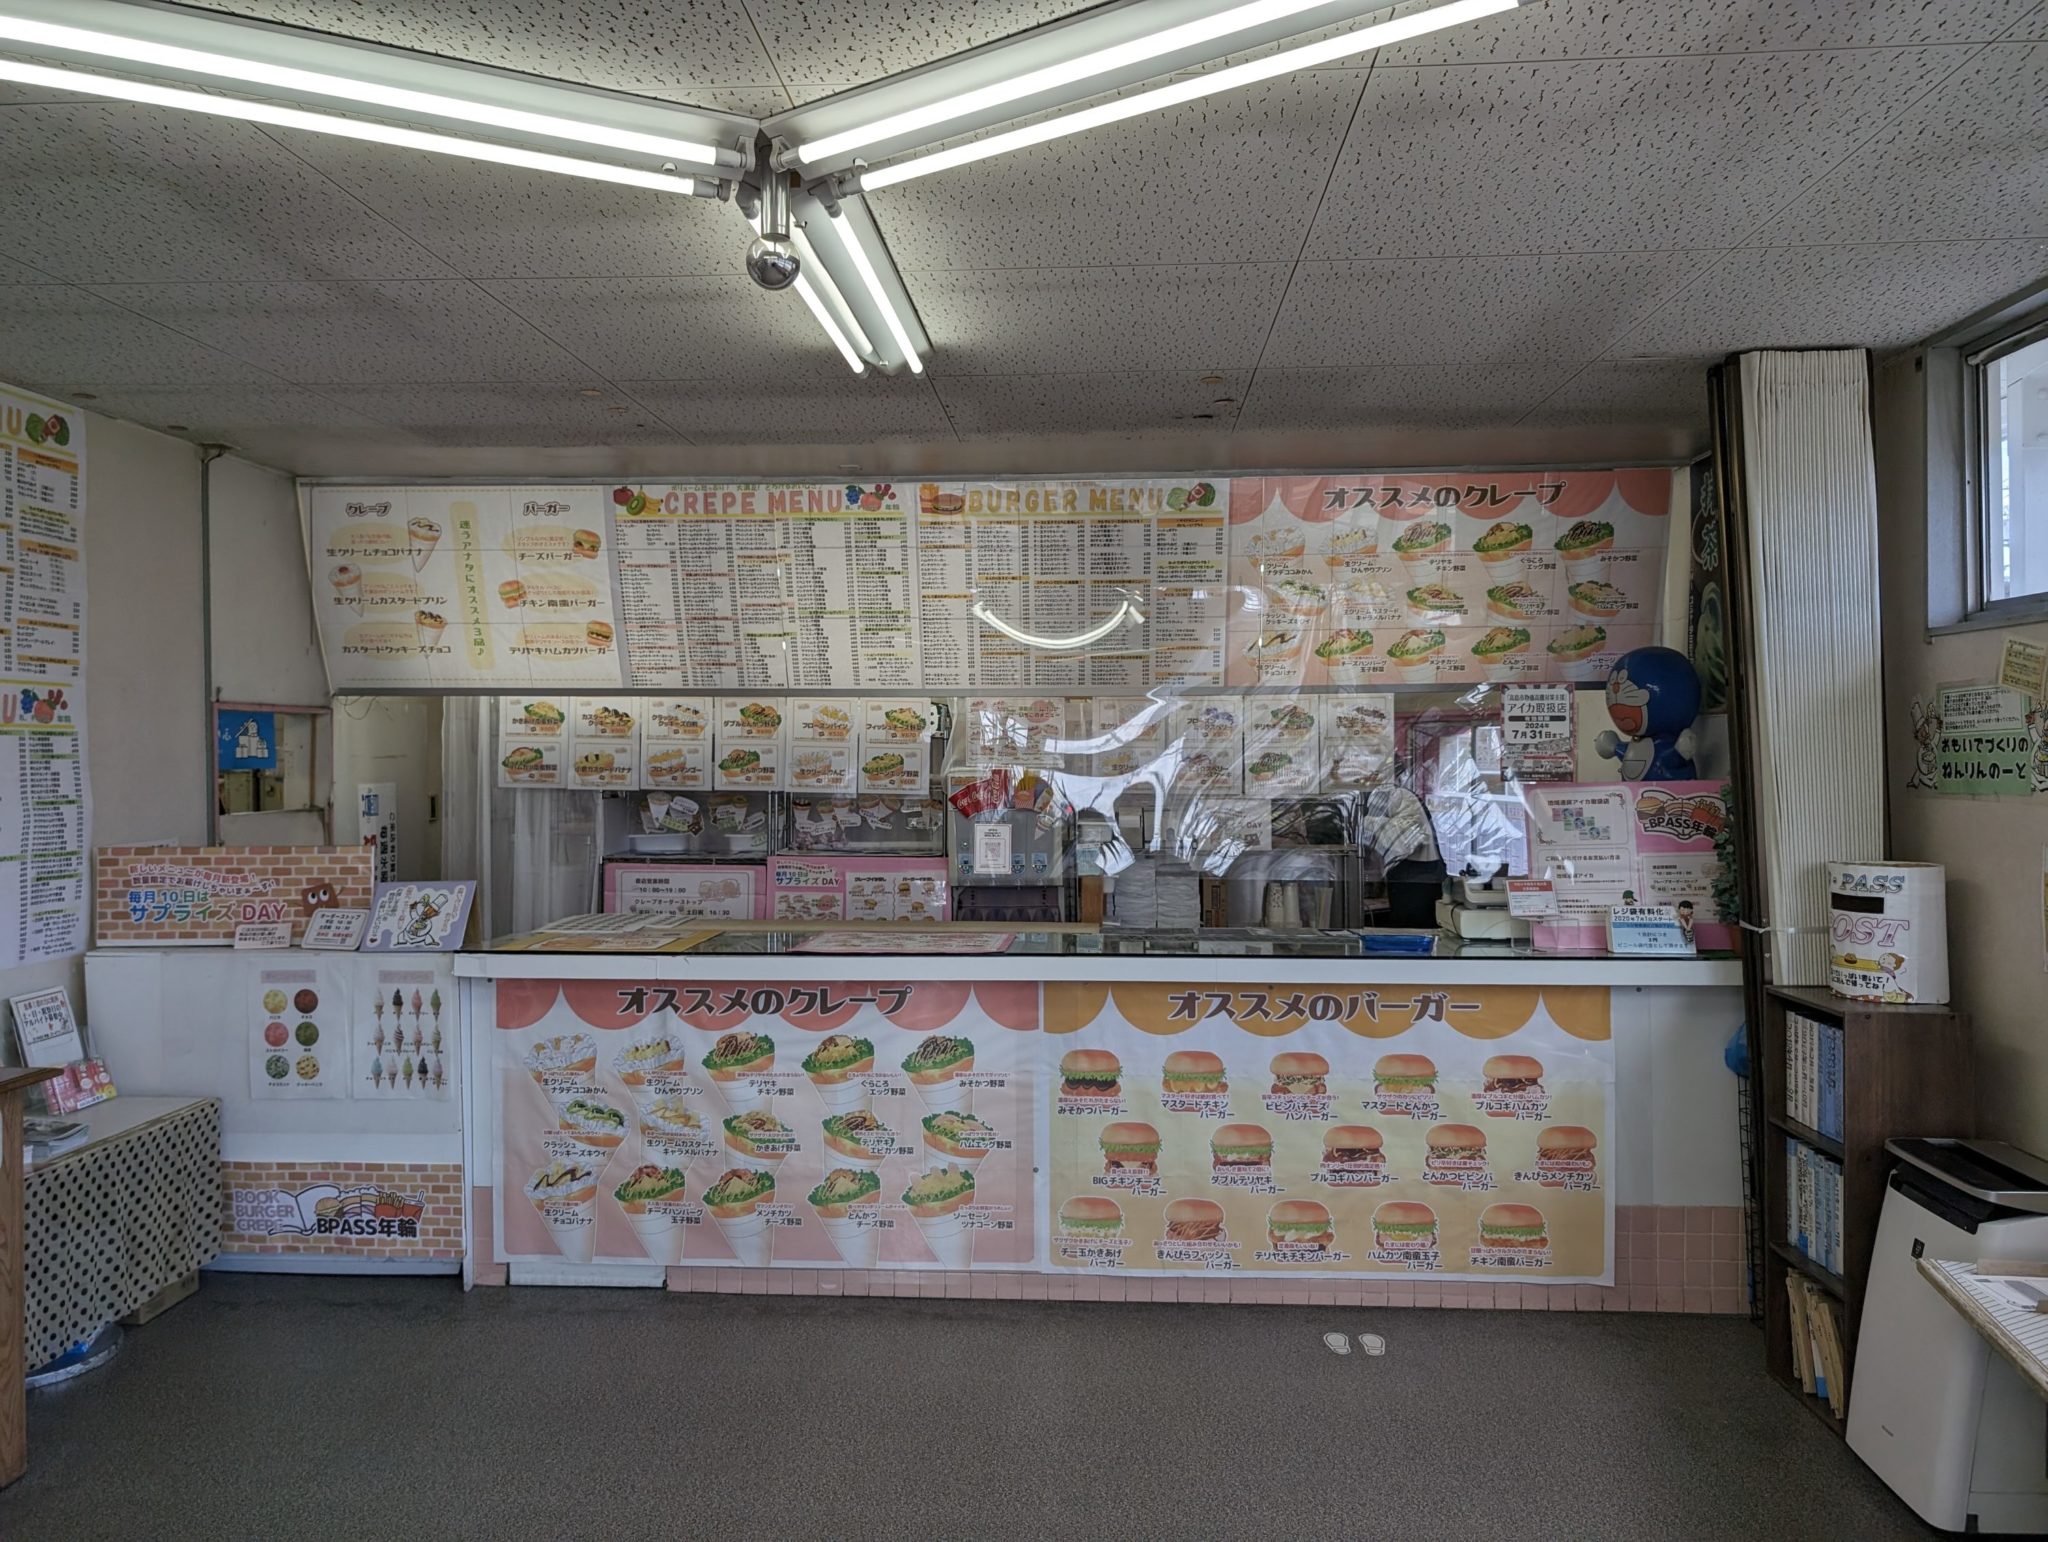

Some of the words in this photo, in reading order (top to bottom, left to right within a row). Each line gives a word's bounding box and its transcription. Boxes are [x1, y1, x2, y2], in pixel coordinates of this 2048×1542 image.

[968, 489, 1078, 513] BURGER
[1089, 487, 1163, 512] MENU
[1323, 481, 1568, 509] オススメのクレープ
[664, 491, 756, 514] CREPE
[768, 489, 842, 514] MENU
[346, 502, 392, 517] クレープ
[523, 502, 570, 516] バーガー
[518, 552, 582, 561] チーズバーガー
[1507, 703, 1567, 713] アイカ取扱店
[1512, 730, 1564, 740] 7月31日まで
[1941, 737, 2029, 753] おもいでづくりの
[1941, 761, 2026, 779] ねんりんのーと
[776, 877, 820, 886] サプライズ
[822, 878, 840, 886] DAY
[634, 898, 703, 906] クレープオーダーストップ
[129, 902, 237, 923] サプライズ
[242, 903, 287, 922] DAY
[617, 986, 913, 1016] オススメのクレープ
[1168, 991, 1481, 1023] オススメのバーガー
[542, 1078, 578, 1087] 生クリーム
[646, 1078, 681, 1087] 生クリーム
[748, 1079, 778, 1088] テリヤキ
[860, 1079, 890, 1088] ぐらころ
[959, 1079, 1006, 1088] みそかつ野菜
[551, 1086, 608, 1095] ナタデココみかん
[654, 1087, 703, 1096] ひんやりプリン
[757, 1088, 795, 1096] チキン野菜
[869, 1088, 907, 1096] エッグ野菜
[1161, 1100, 1229, 1109] マスタードチキン
[1265, 1102, 1328, 1111] ビビンバチーズ
[1361, 1101, 1440, 1111] マスタードとんかつ
[1475, 1101, 1548, 1111] ブルコギハムカツ
[1058, 1106, 1129, 1115] みそかつバーガー
[1200, 1110, 1235, 1120] バーガー
[1285, 1112, 1338, 1122] ハンバーガー
[1411, 1111, 1447, 1121] バーガー
[1515, 1111, 1552, 1121] バーガー
[543, 1141, 578, 1149] クラッシュ
[646, 1139, 715, 1148] 生クリームカスタード
[755, 1143, 802, 1152] かきあげ野菜
[959, 1140, 1012, 1149] ハムエッグ野菜
[551, 1149, 608, 1158] クッキーズキウイ
[662, 1147, 719, 1156] キャラメルバナナ
[870, 1146, 914, 1155] エビカツ野菜
[1092, 1176, 1161, 1186] BIGチキンチーズ
[1211, 1175, 1272, 1185] ダブルテリヤキ
[1310, 1172, 1399, 1183] ブルコギハンバーガー
[1422, 1171, 1493, 1181] とんかつビビンバ
[1513, 1171, 1593, 1181] きんぴらメンチカツ
[1131, 1186, 1168, 1196] バーガー
[1249, 1185, 1286, 1195] バーガー
[1462, 1181, 1498, 1192] バーガー
[1564, 1181, 1601, 1192] バーガー
[235, 1190, 279, 1204] BOOK
[235, 1205, 295, 1218] BURGER
[544, 1208, 579, 1217] 生クリーム
[647, 1207, 704, 1217] チーズハンバーグ
[756, 1209, 792, 1218] メンチカツ
[847, 1211, 878, 1220] とんかつ
[953, 1212, 990, 1221] ソーセージ
[552, 1217, 594, 1226] チョコバナナ
[671, 1216, 701, 1225] 玉子野菜
[765, 1217, 803, 1226] チーズ野菜
[857, 1219, 895, 1229] チーズ野菜
[961, 1220, 1014, 1230] ツナコーン野菜
[317, 1218, 418, 1238] BPASS年輪
[1060, 1248, 1122, 1258] チー玉かきあげ
[1156, 1250, 1232, 1261] きんぴらフィッシュ
[1254, 1251, 1351, 1262] テリヤキチキンバーガー
[1367, 1251, 1440, 1261] ハムカツ南蛮玉子
[1089, 1258, 1125, 1268] バーガー
[1205, 1260, 1241, 1270] バーガー
[1407, 1261, 1443, 1271] バーガー
[1470, 1256, 1553, 1266] チキン南蛮バーガー
